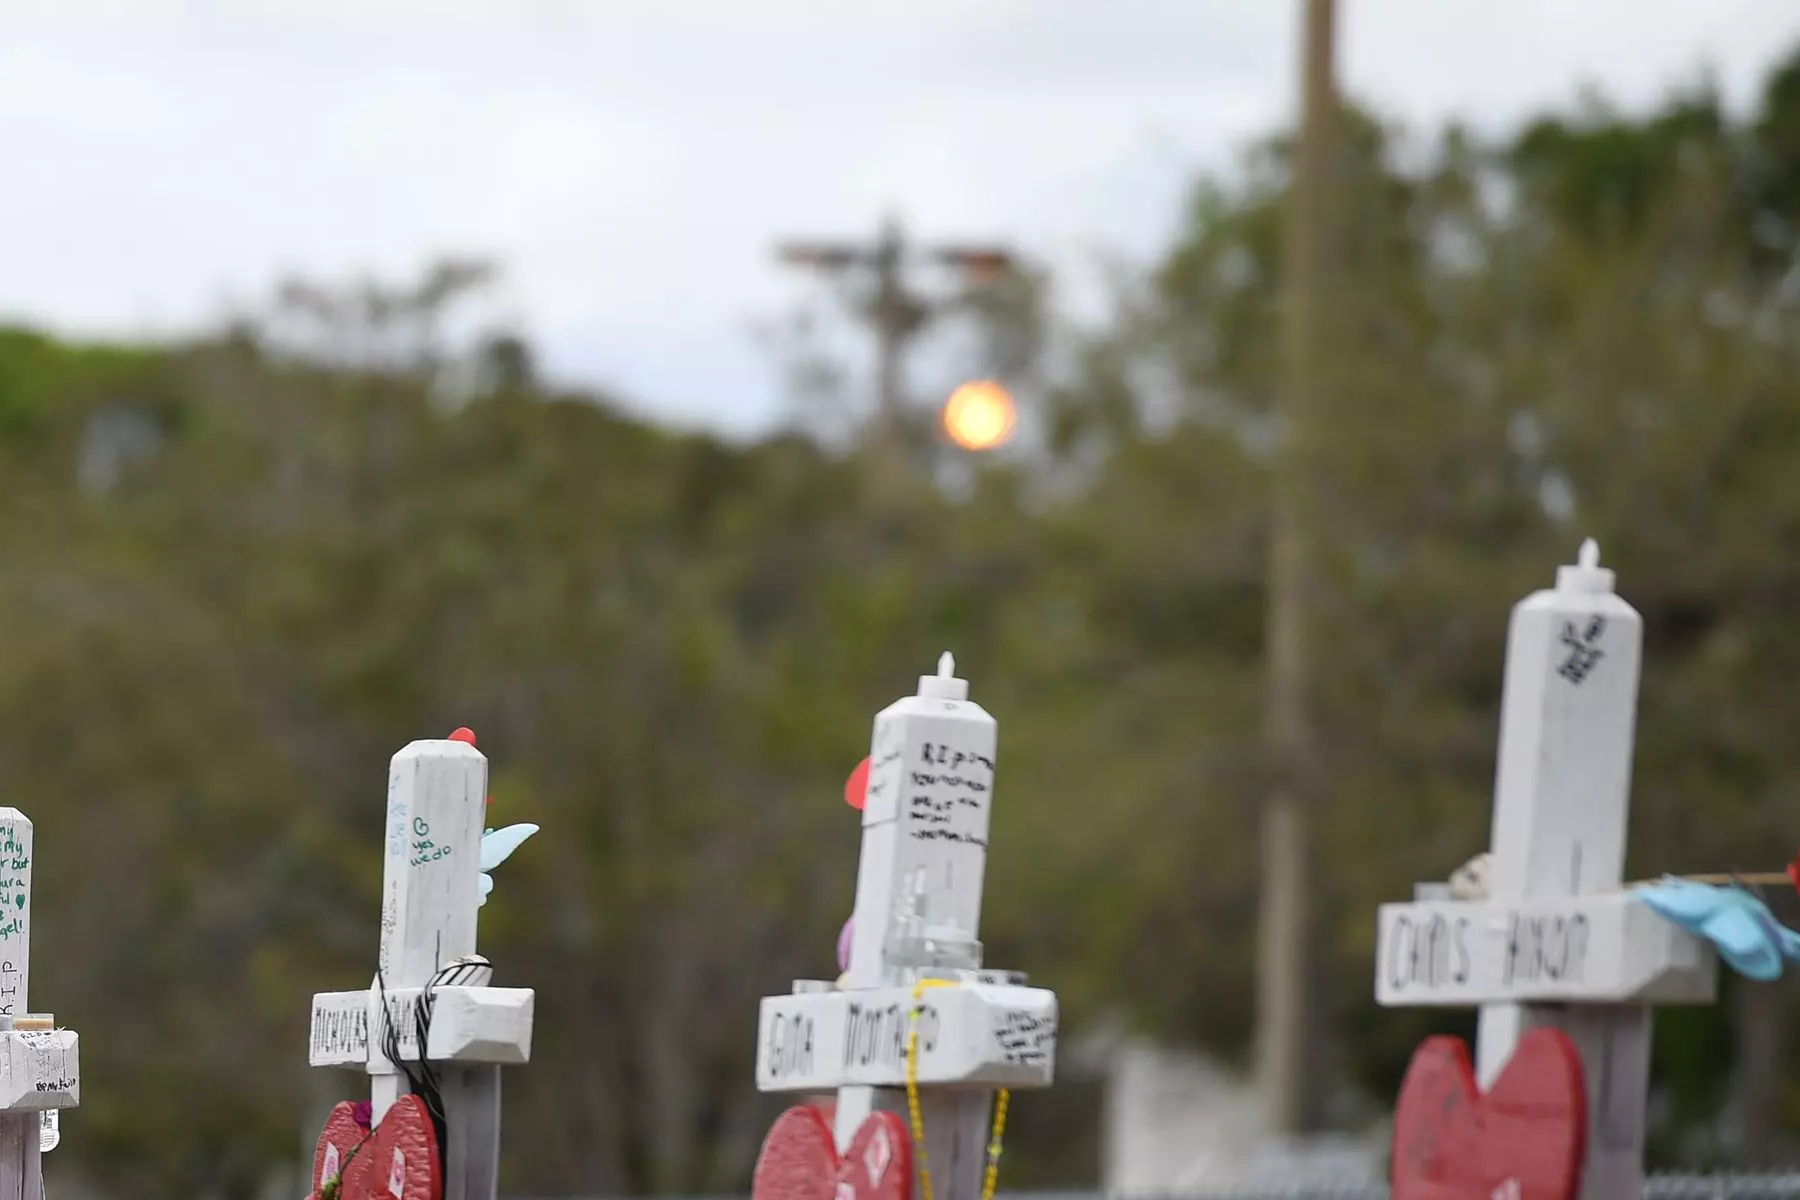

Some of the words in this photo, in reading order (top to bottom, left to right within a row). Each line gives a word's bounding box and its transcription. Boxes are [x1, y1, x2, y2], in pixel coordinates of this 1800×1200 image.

[412, 837, 434, 851] yes
[410, 852, 431, 867] we
[432, 844, 452, 861] do
[11, 857, 29, 870] but
[15, 880, 25, 888] a
